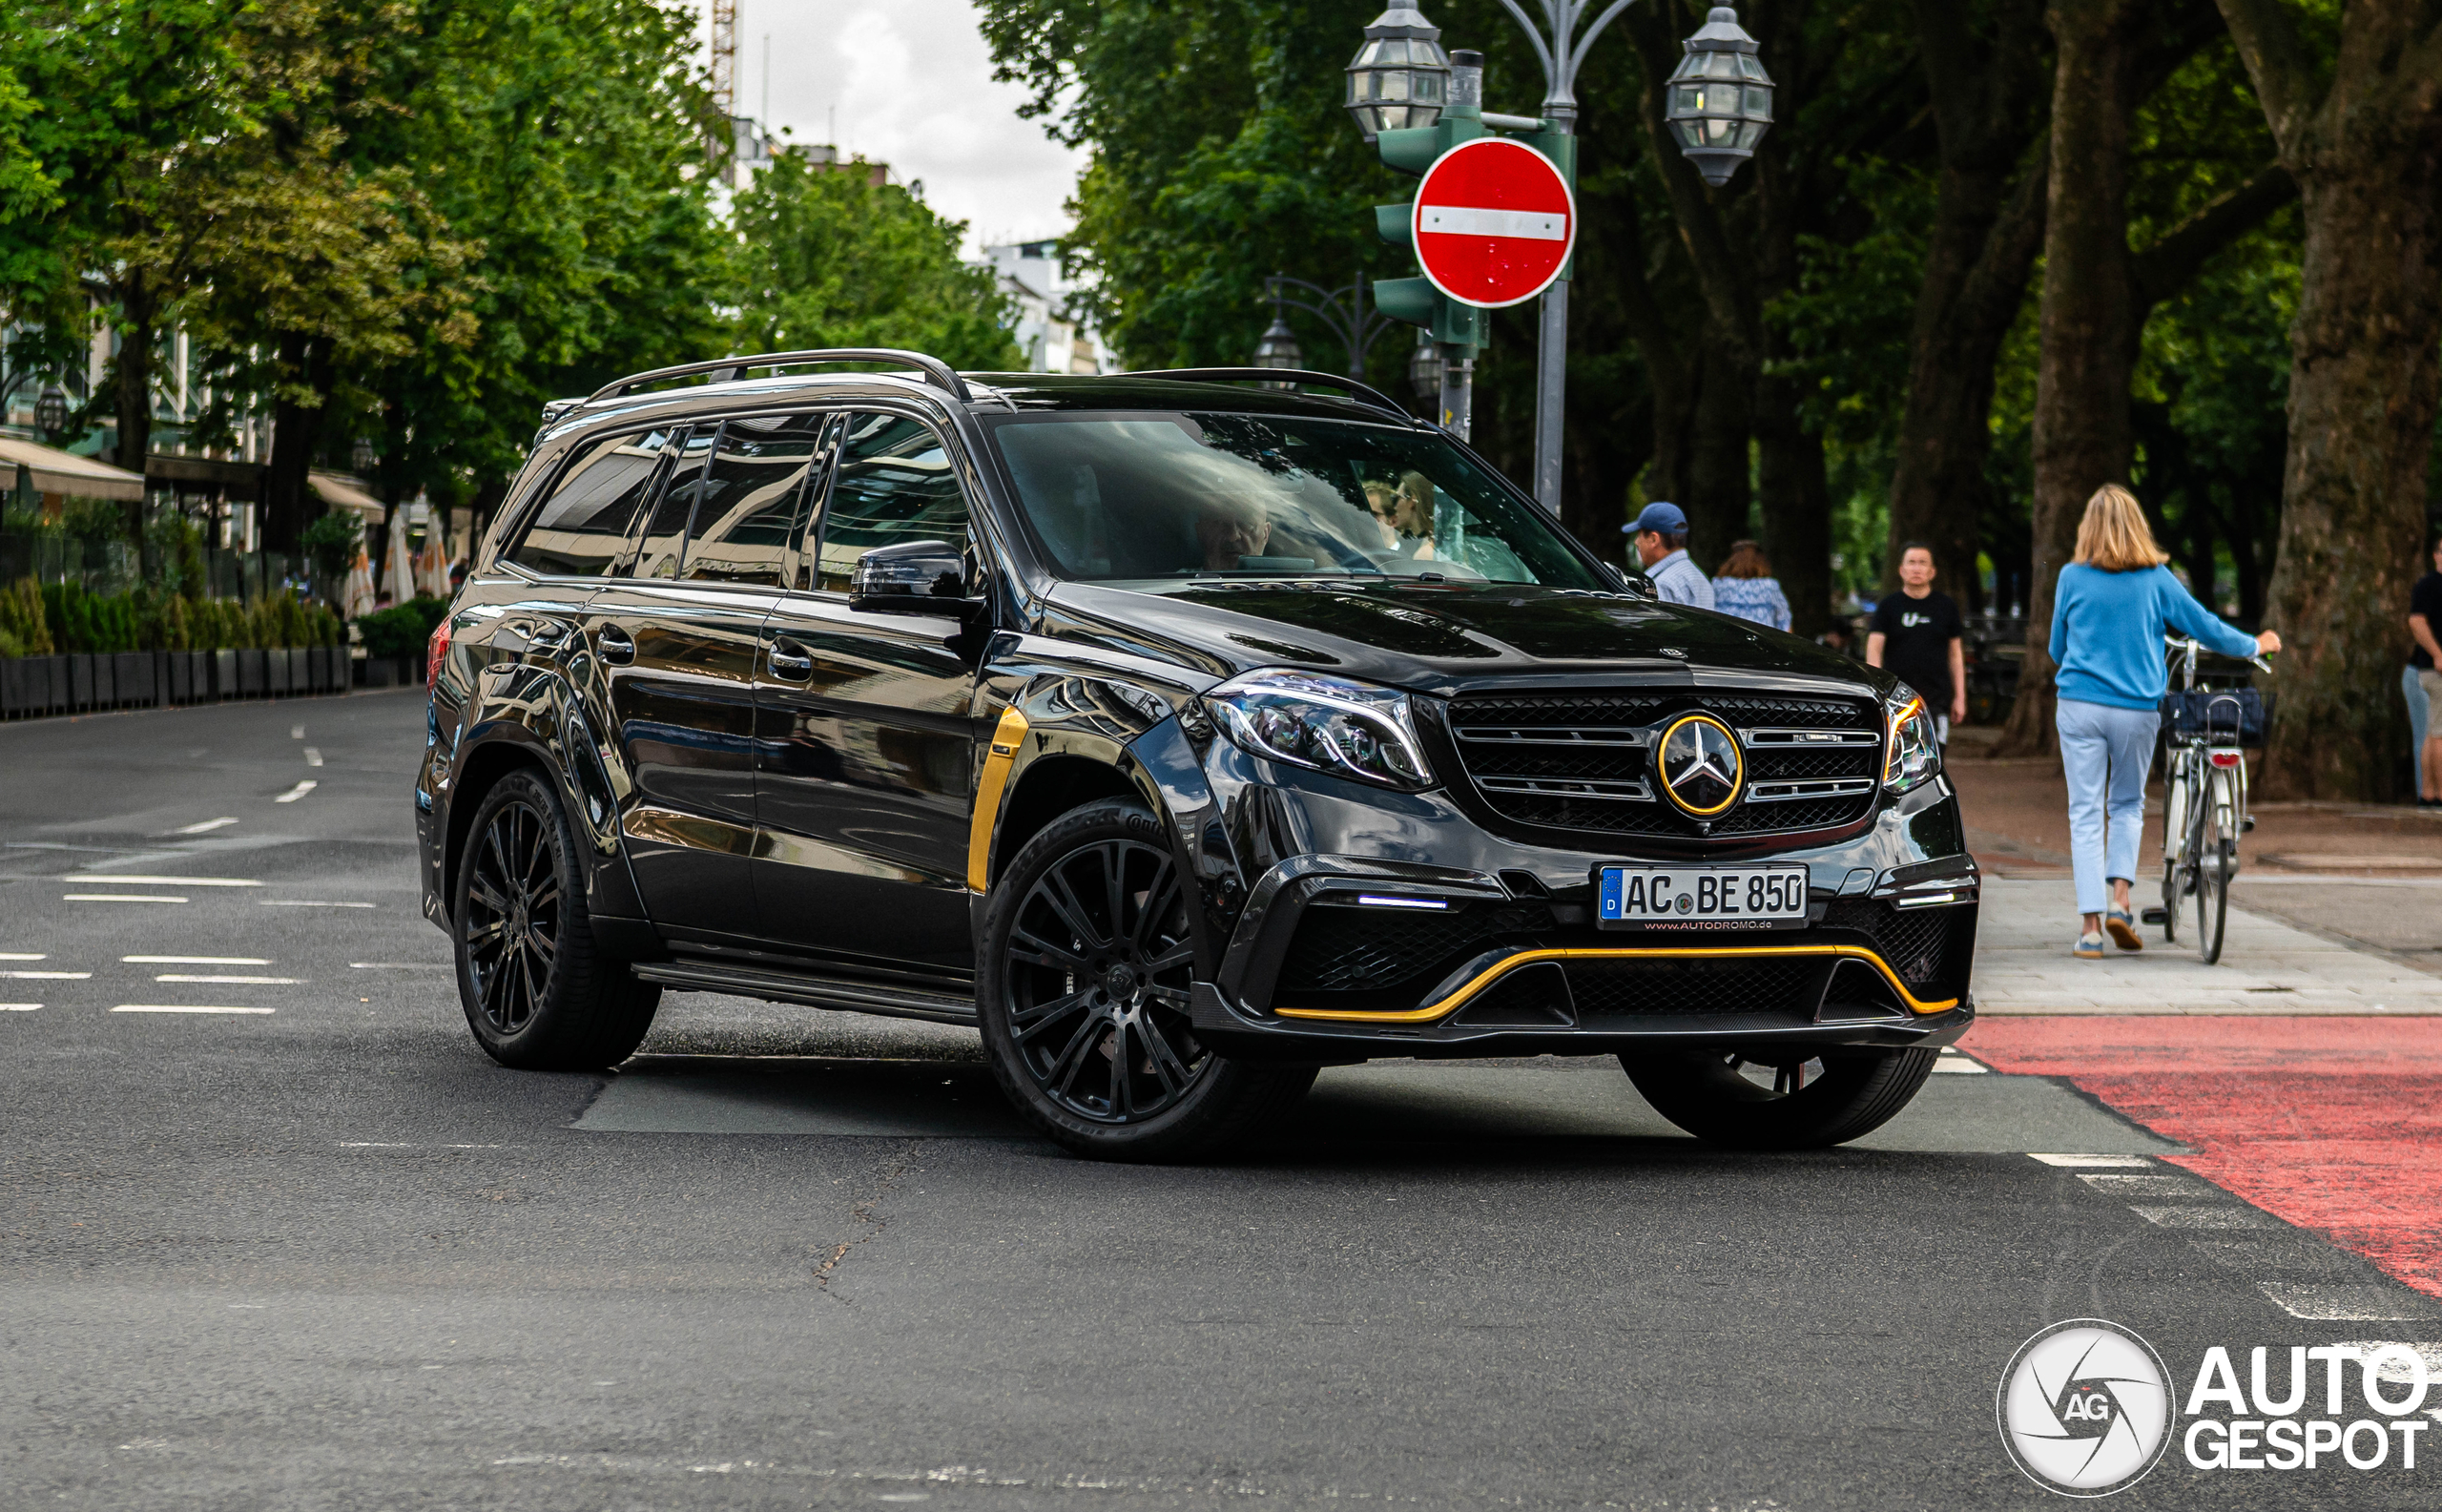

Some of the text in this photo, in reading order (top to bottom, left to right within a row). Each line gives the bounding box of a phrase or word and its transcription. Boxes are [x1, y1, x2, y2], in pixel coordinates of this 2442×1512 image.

[1625, 874, 1802, 914] AC BE 850
[1606, 900, 1616, 911] D
[1645, 921, 1772, 930] www.AUTODROMO.de
